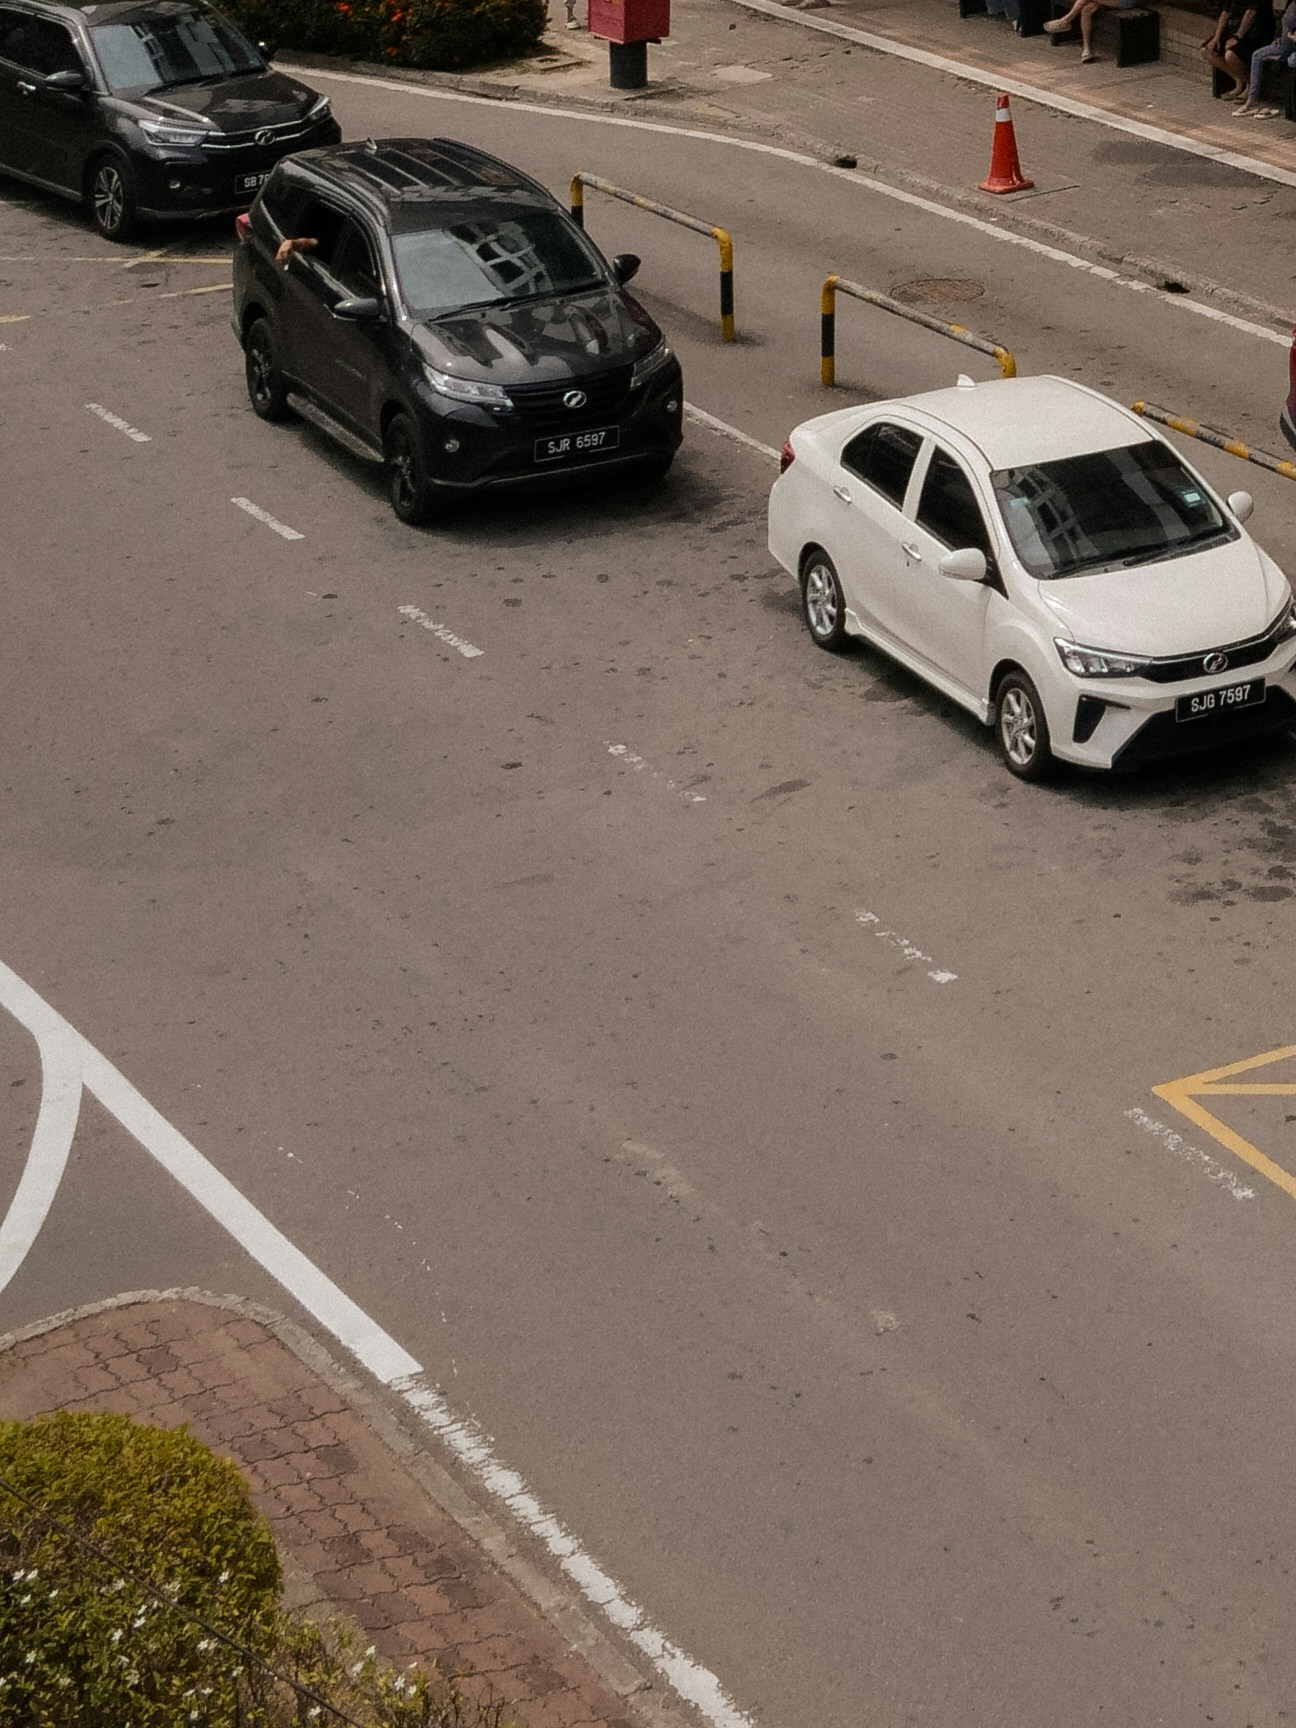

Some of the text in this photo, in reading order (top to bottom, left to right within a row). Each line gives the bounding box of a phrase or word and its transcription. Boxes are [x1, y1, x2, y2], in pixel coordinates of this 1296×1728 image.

[548, 431, 606, 453] SJR 6597
[1191, 685, 1250, 712] SJG 7597
